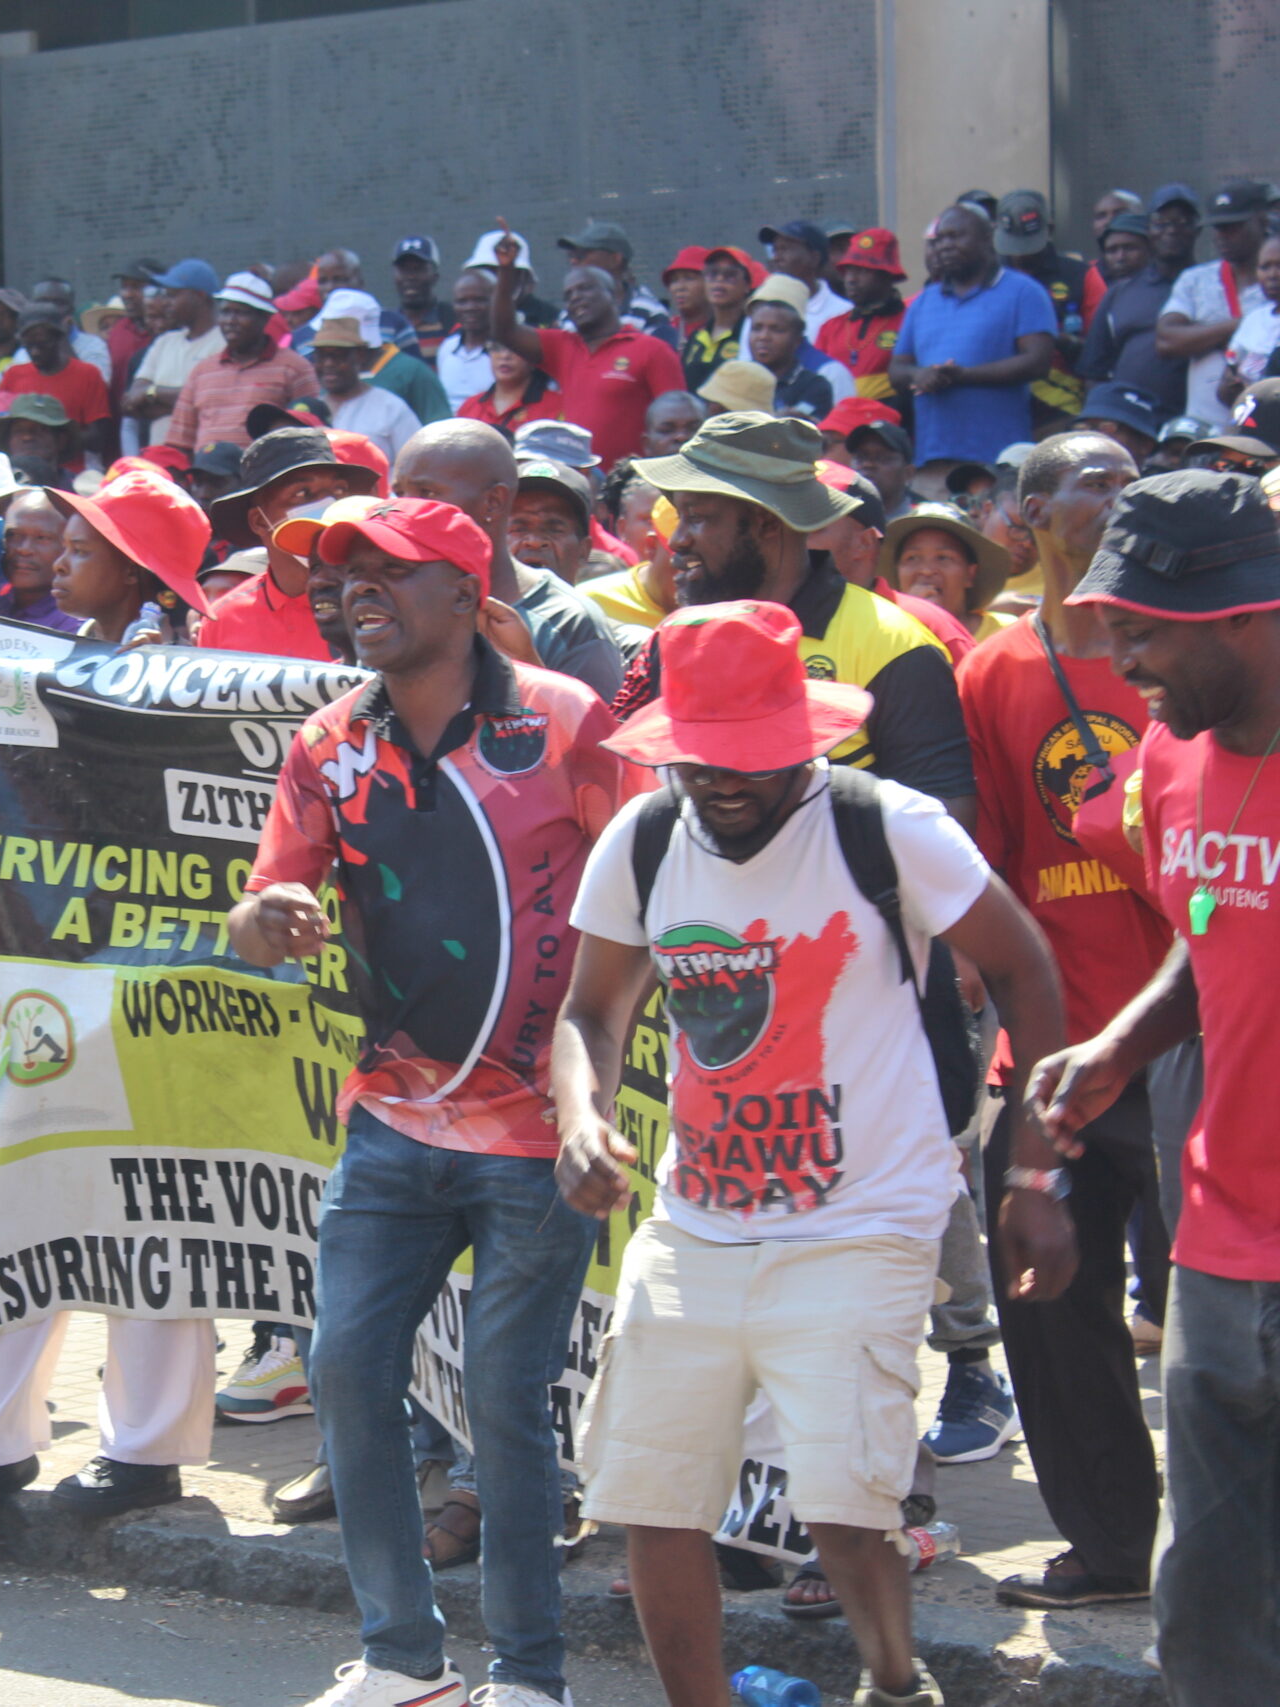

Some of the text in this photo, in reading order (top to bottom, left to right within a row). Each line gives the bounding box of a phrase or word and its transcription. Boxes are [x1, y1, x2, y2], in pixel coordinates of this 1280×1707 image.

[52, 897, 92, 945] A
[122, 979, 280, 1038] WORKERS
[711, 1084, 842, 1133] JOIN
[110, 1157, 327, 1243] THE VOIC
[180, 1237, 280, 1313] THE
